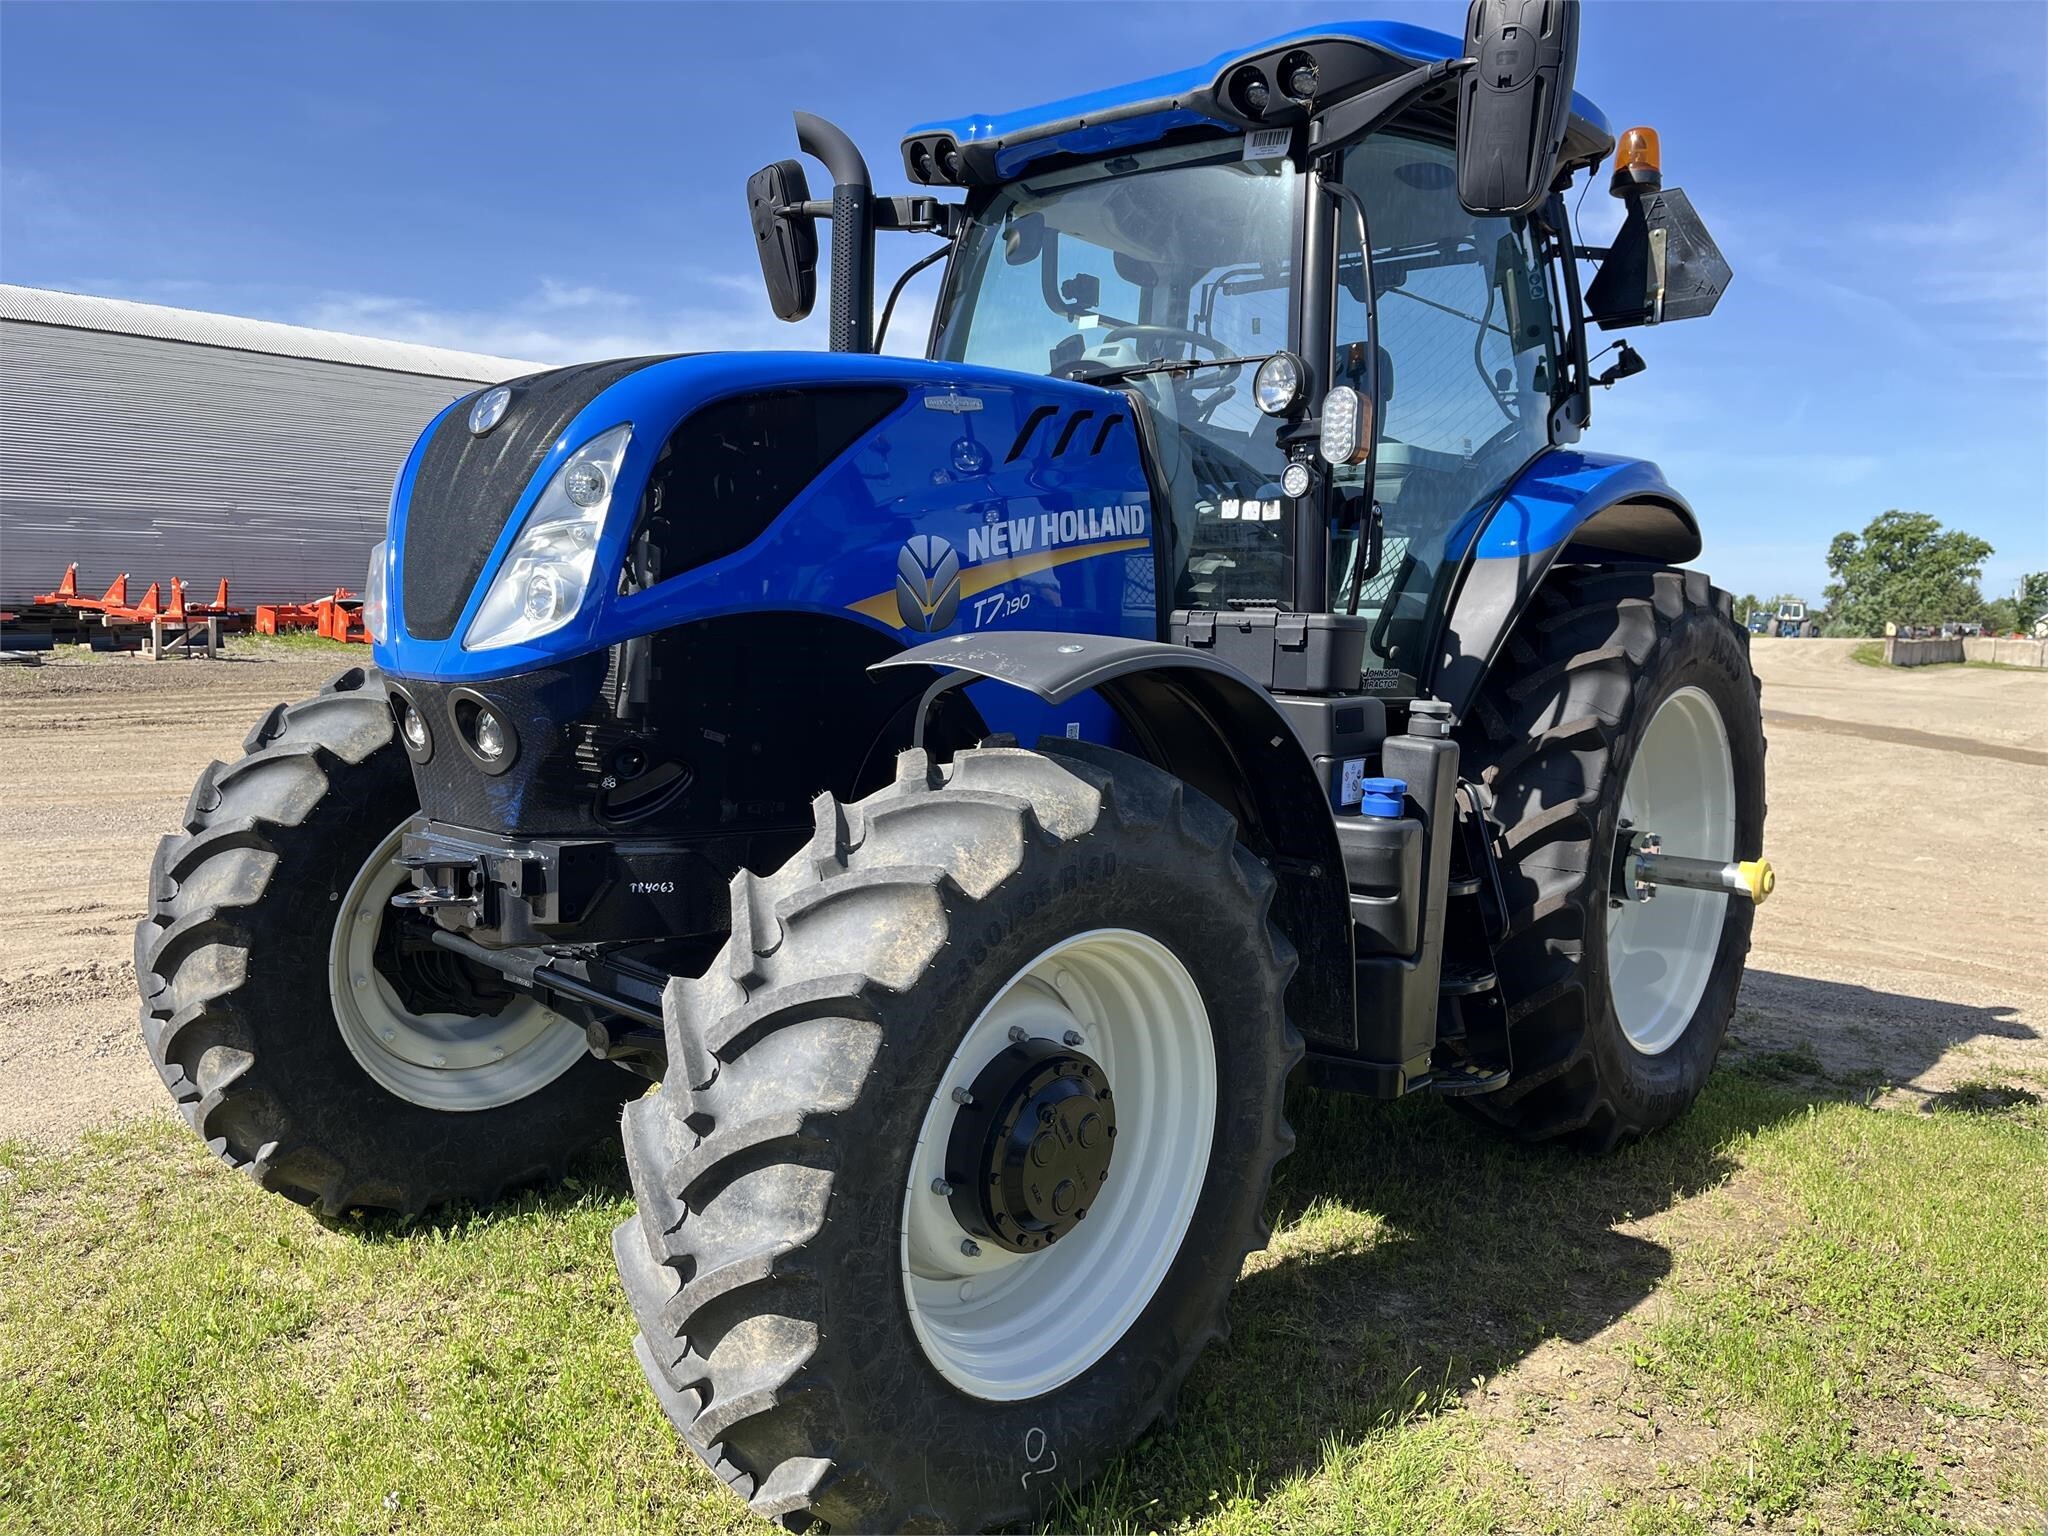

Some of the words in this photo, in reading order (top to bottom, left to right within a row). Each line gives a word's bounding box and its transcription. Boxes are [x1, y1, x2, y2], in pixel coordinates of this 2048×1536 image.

[968, 516, 1036, 563] NEW
[1040, 504, 1145, 547] HOLLAND
[973, 592, 1030, 629] T7.190
[1362, 667, 1399, 678] JOHNSON
[1362, 679, 1398, 688] TRACTOR
[629, 881, 675, 893] TR4063
